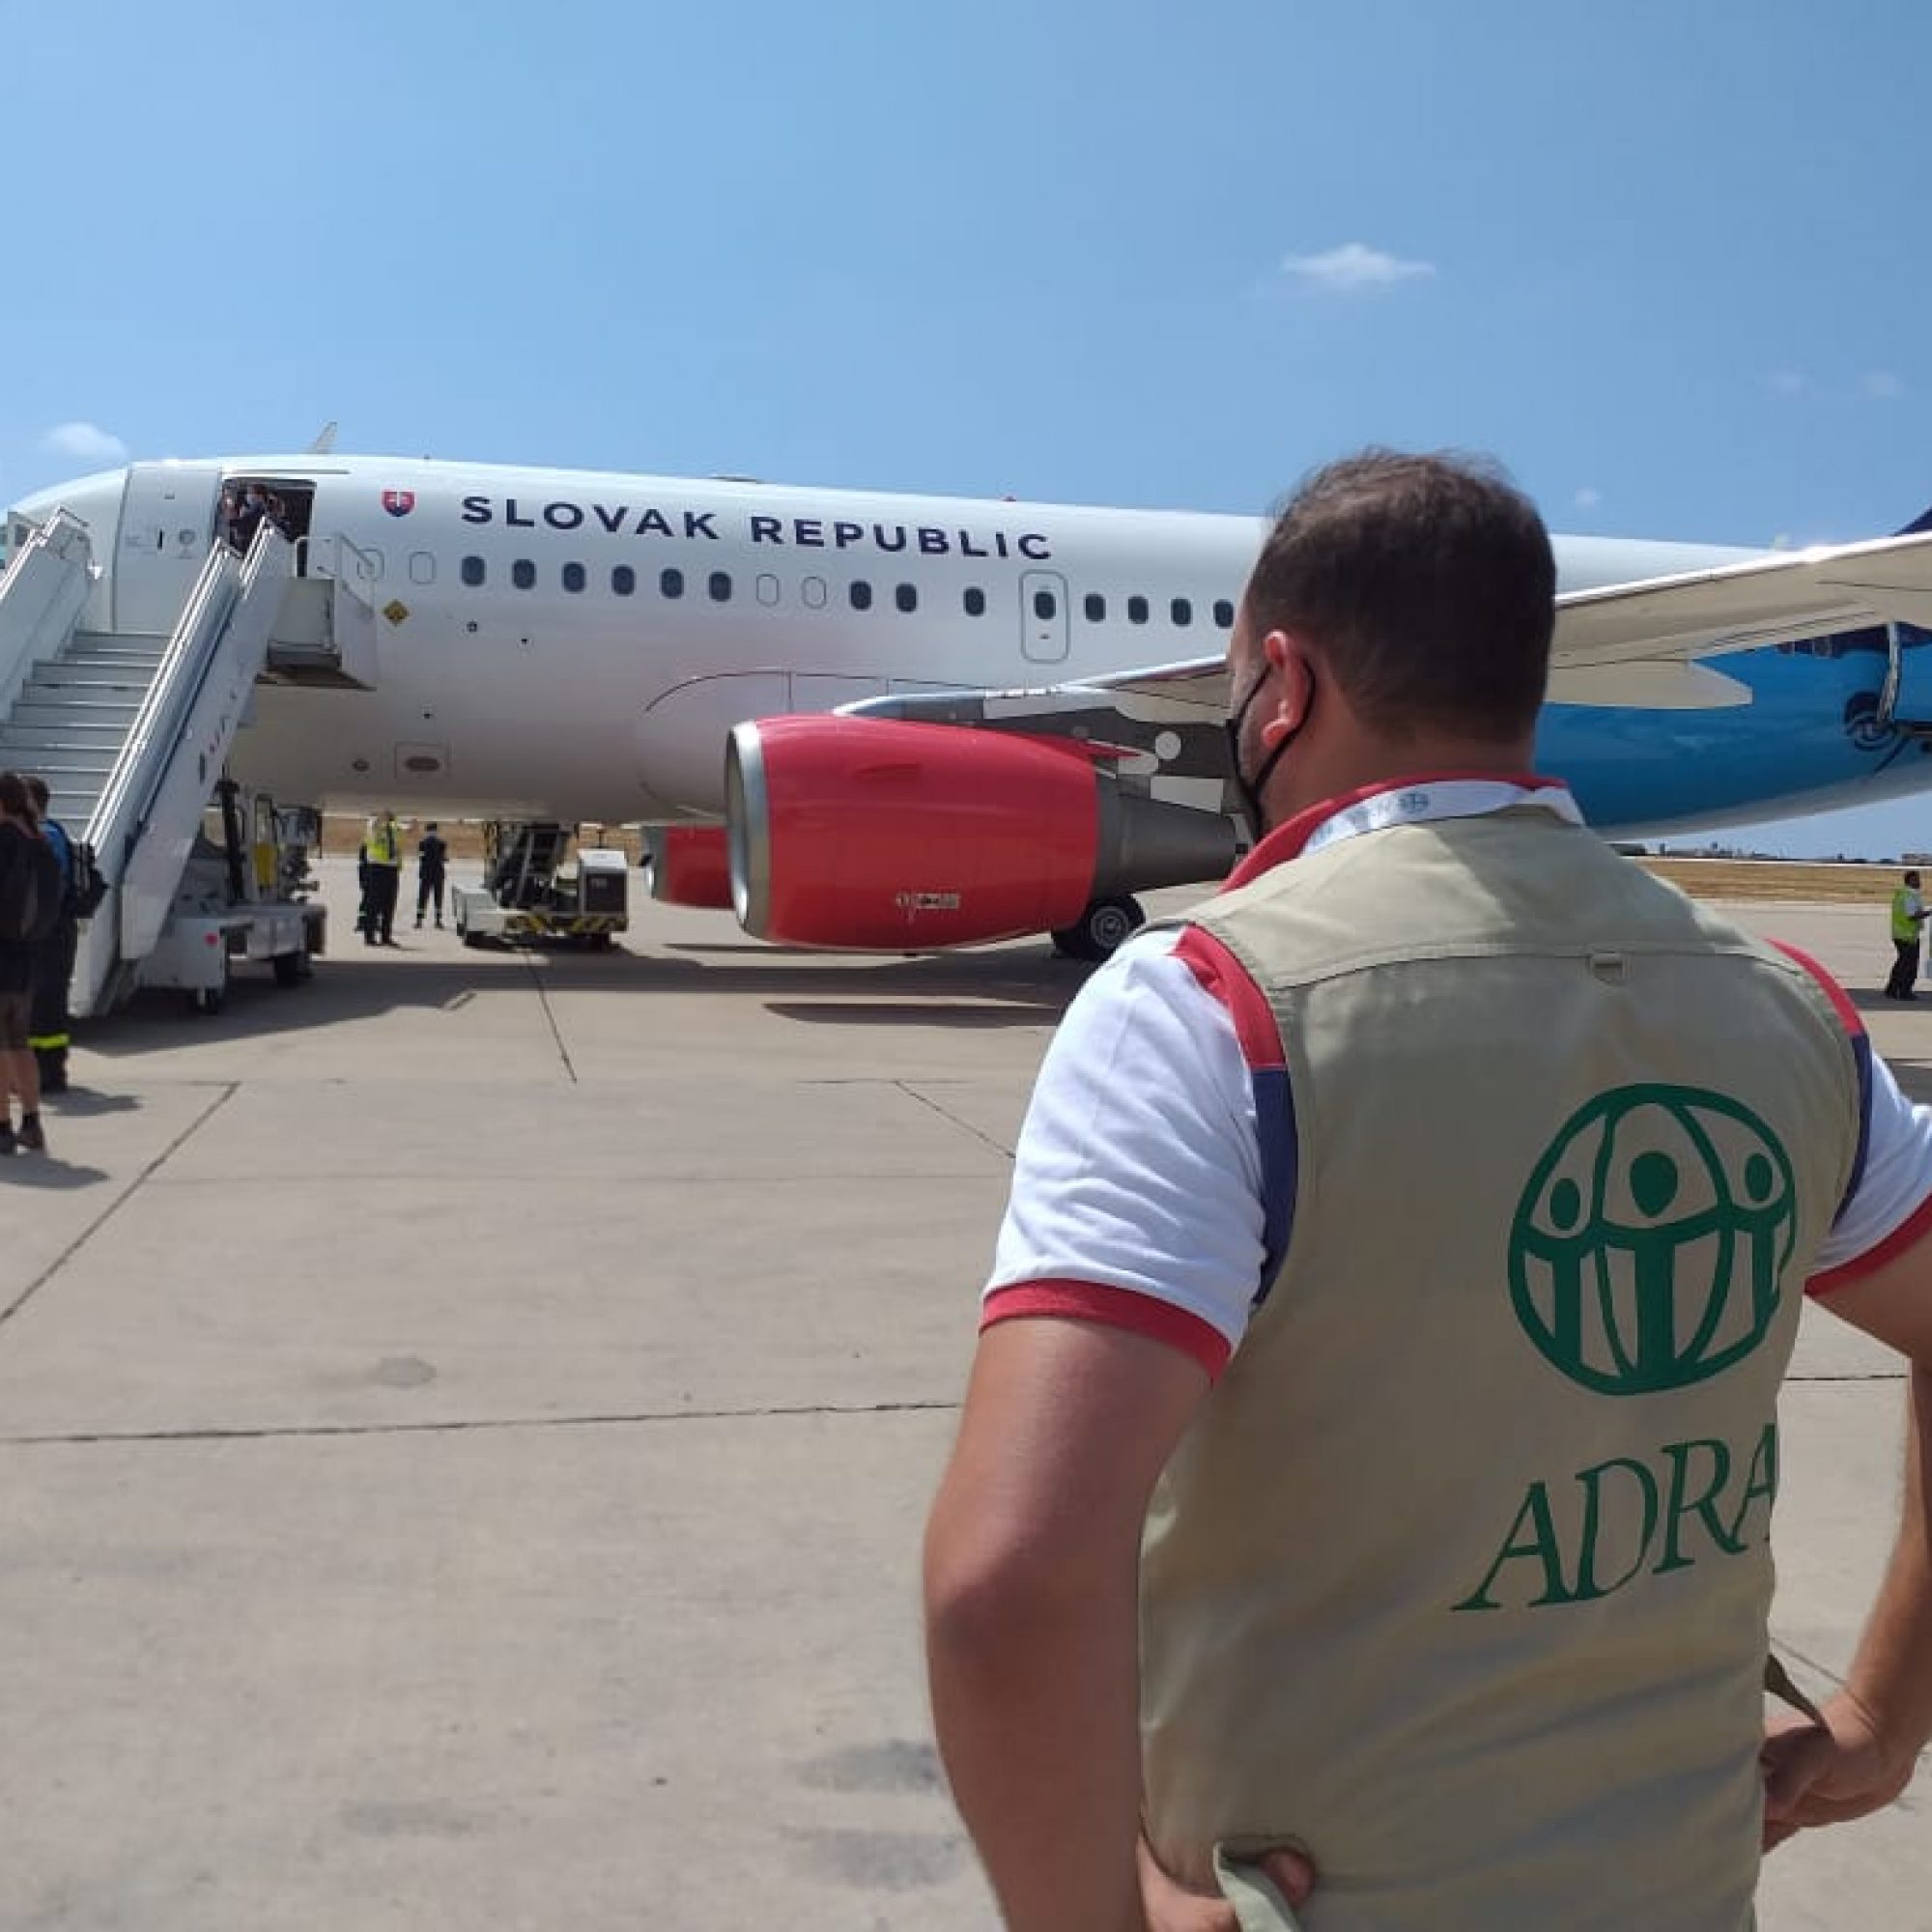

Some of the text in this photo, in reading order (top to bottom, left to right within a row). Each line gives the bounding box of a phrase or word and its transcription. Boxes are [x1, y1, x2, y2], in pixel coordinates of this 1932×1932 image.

[461, 496, 1051, 559] SLOVAK REPUBLIC
[1451, 1422, 1777, 1611] ADRA
